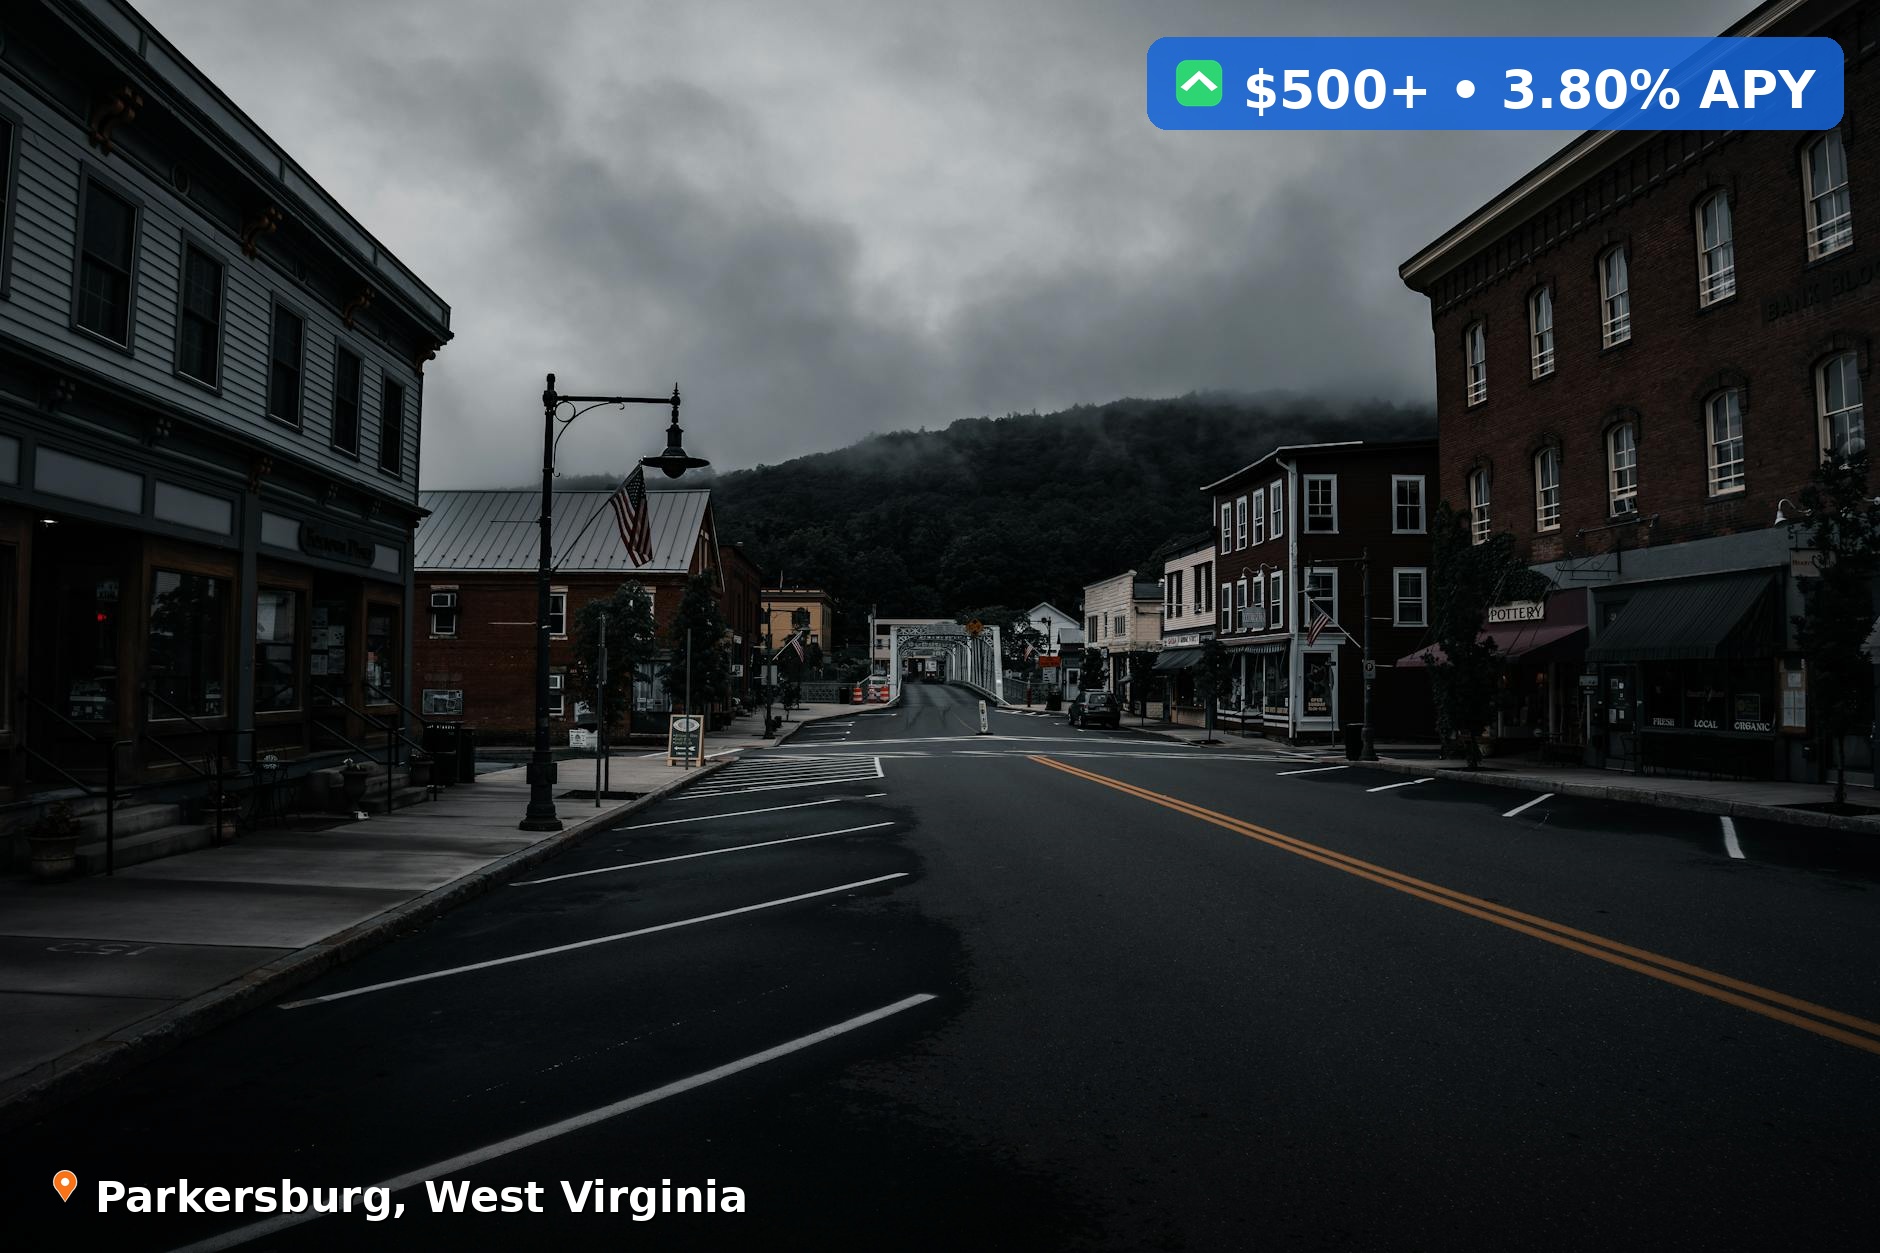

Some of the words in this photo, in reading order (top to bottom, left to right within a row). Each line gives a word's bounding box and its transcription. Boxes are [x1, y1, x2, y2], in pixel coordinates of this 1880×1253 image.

[1767, 283, 1822, 322] BANK
[1832, 261, 1880, 297] BLO
[1490, 606, 1542, 620] POTTERY
[1652, 717, 1675, 727] FRESH
[1694, 719, 1719, 729] LOCAL
[1734, 721, 1771, 732] ORGANIC
